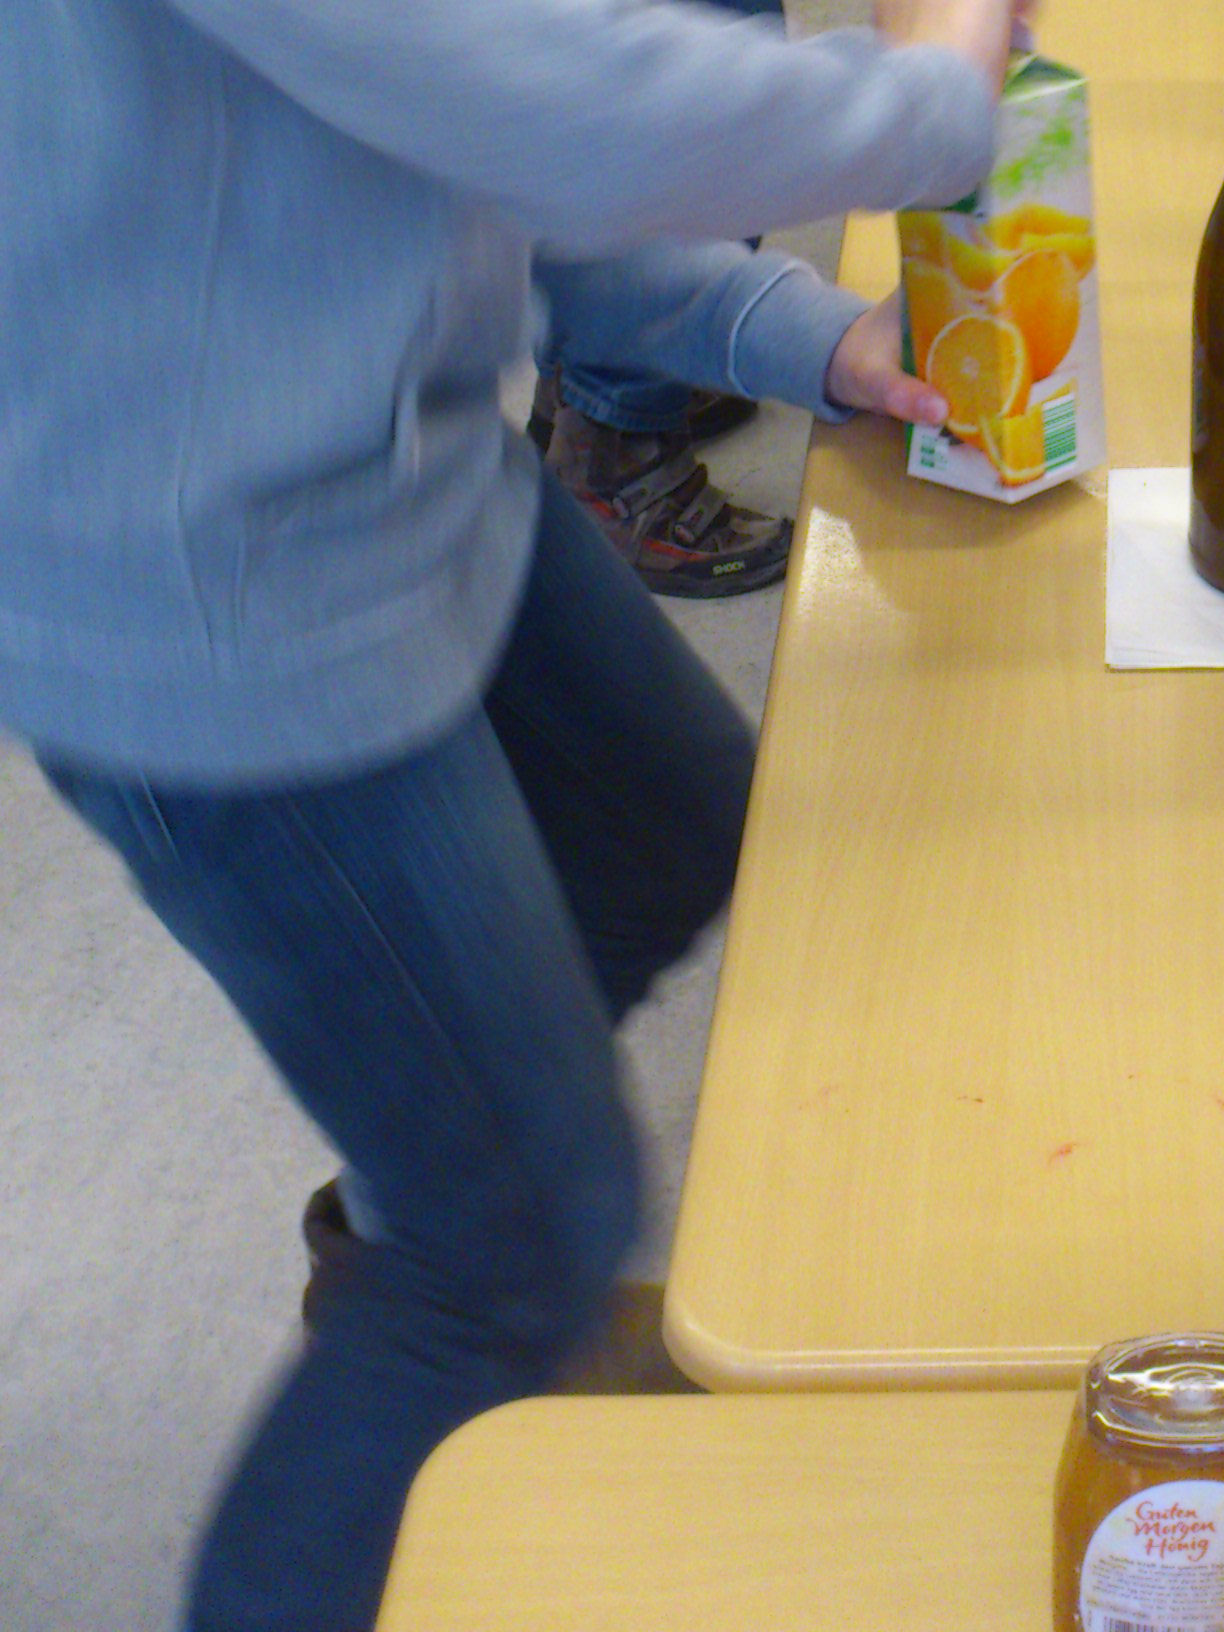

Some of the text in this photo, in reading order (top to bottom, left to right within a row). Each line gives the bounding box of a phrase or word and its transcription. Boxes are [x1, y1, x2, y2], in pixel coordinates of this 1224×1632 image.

[1136, 1501, 1198, 1521] Guten
[1126, 1518, 1216, 1542] Morgen
[1145, 1537, 1209, 1562] Honig
